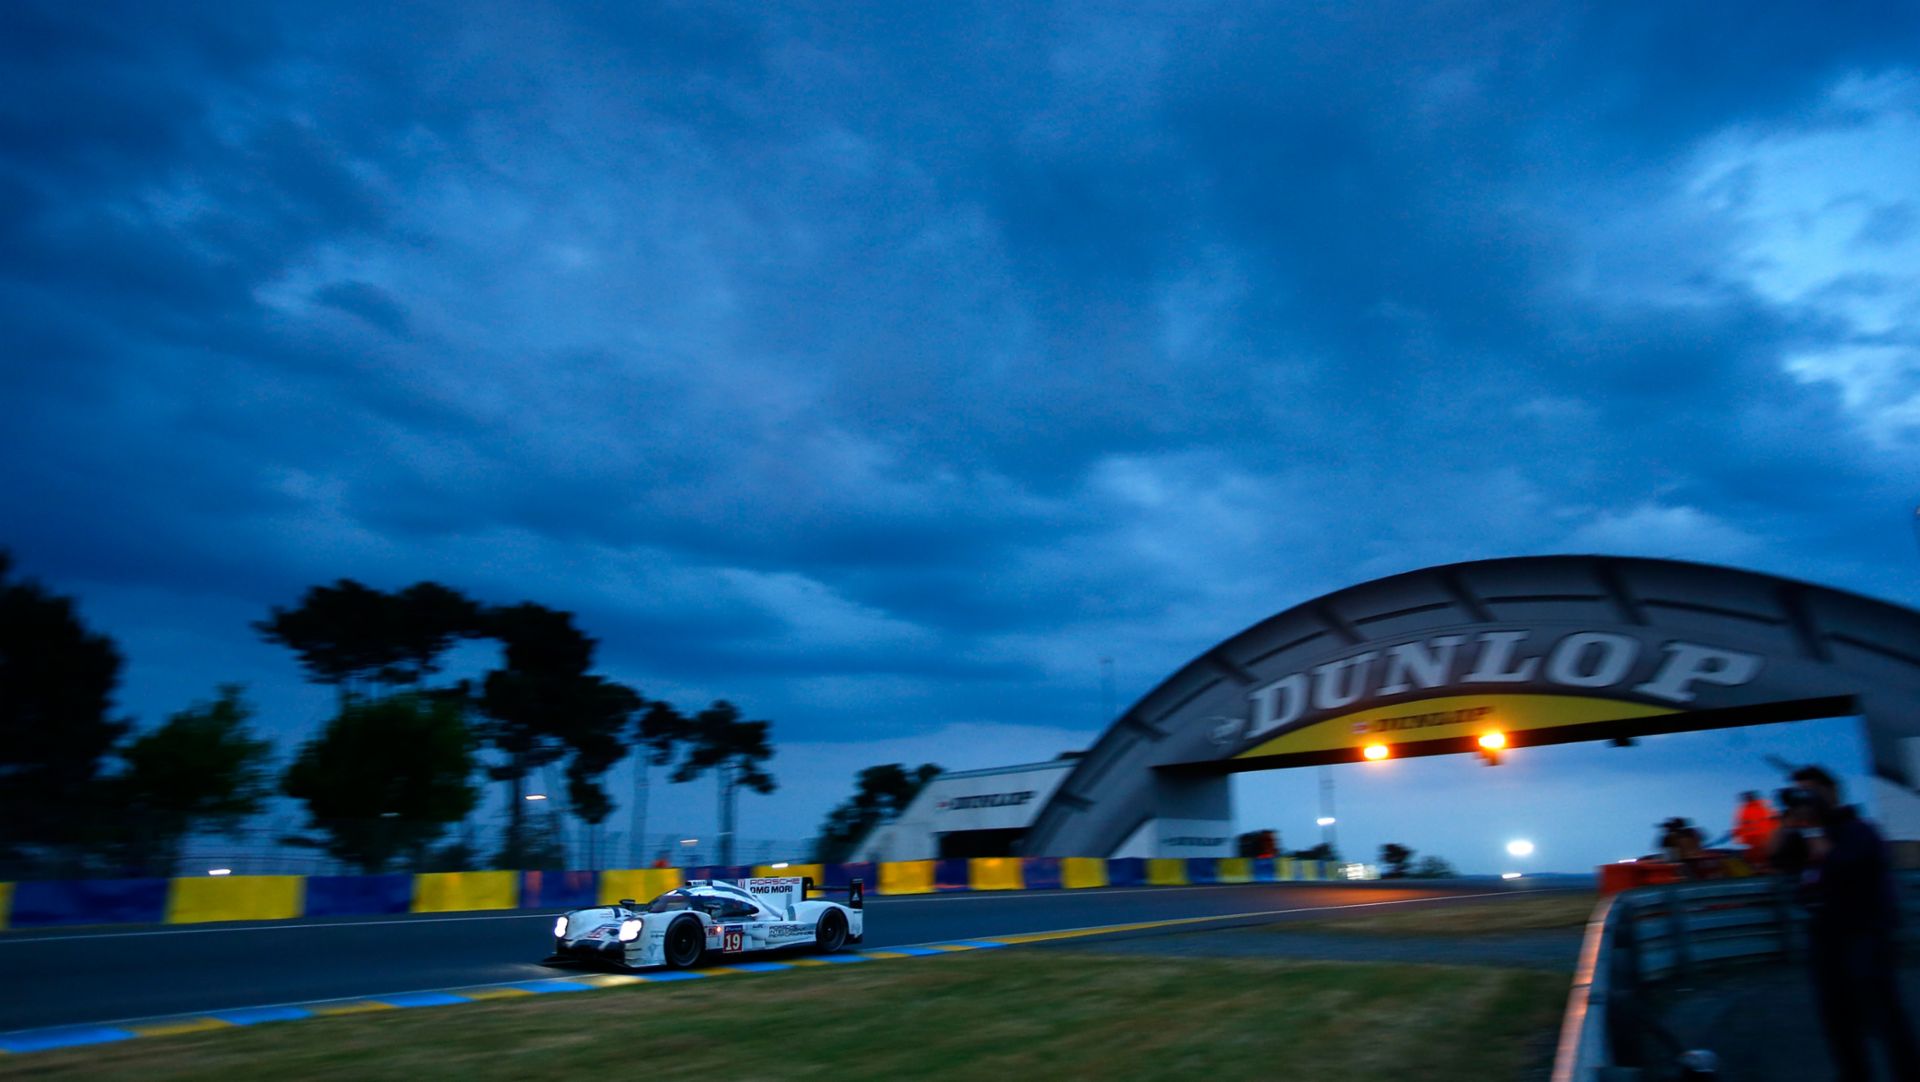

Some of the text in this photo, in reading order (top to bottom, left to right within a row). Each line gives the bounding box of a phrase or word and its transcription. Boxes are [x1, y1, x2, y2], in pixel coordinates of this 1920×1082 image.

[1246, 629, 1765, 739] DUNLOP
[750, 878, 800, 886] PORSCHE
[725, 933, 740, 950] 19
